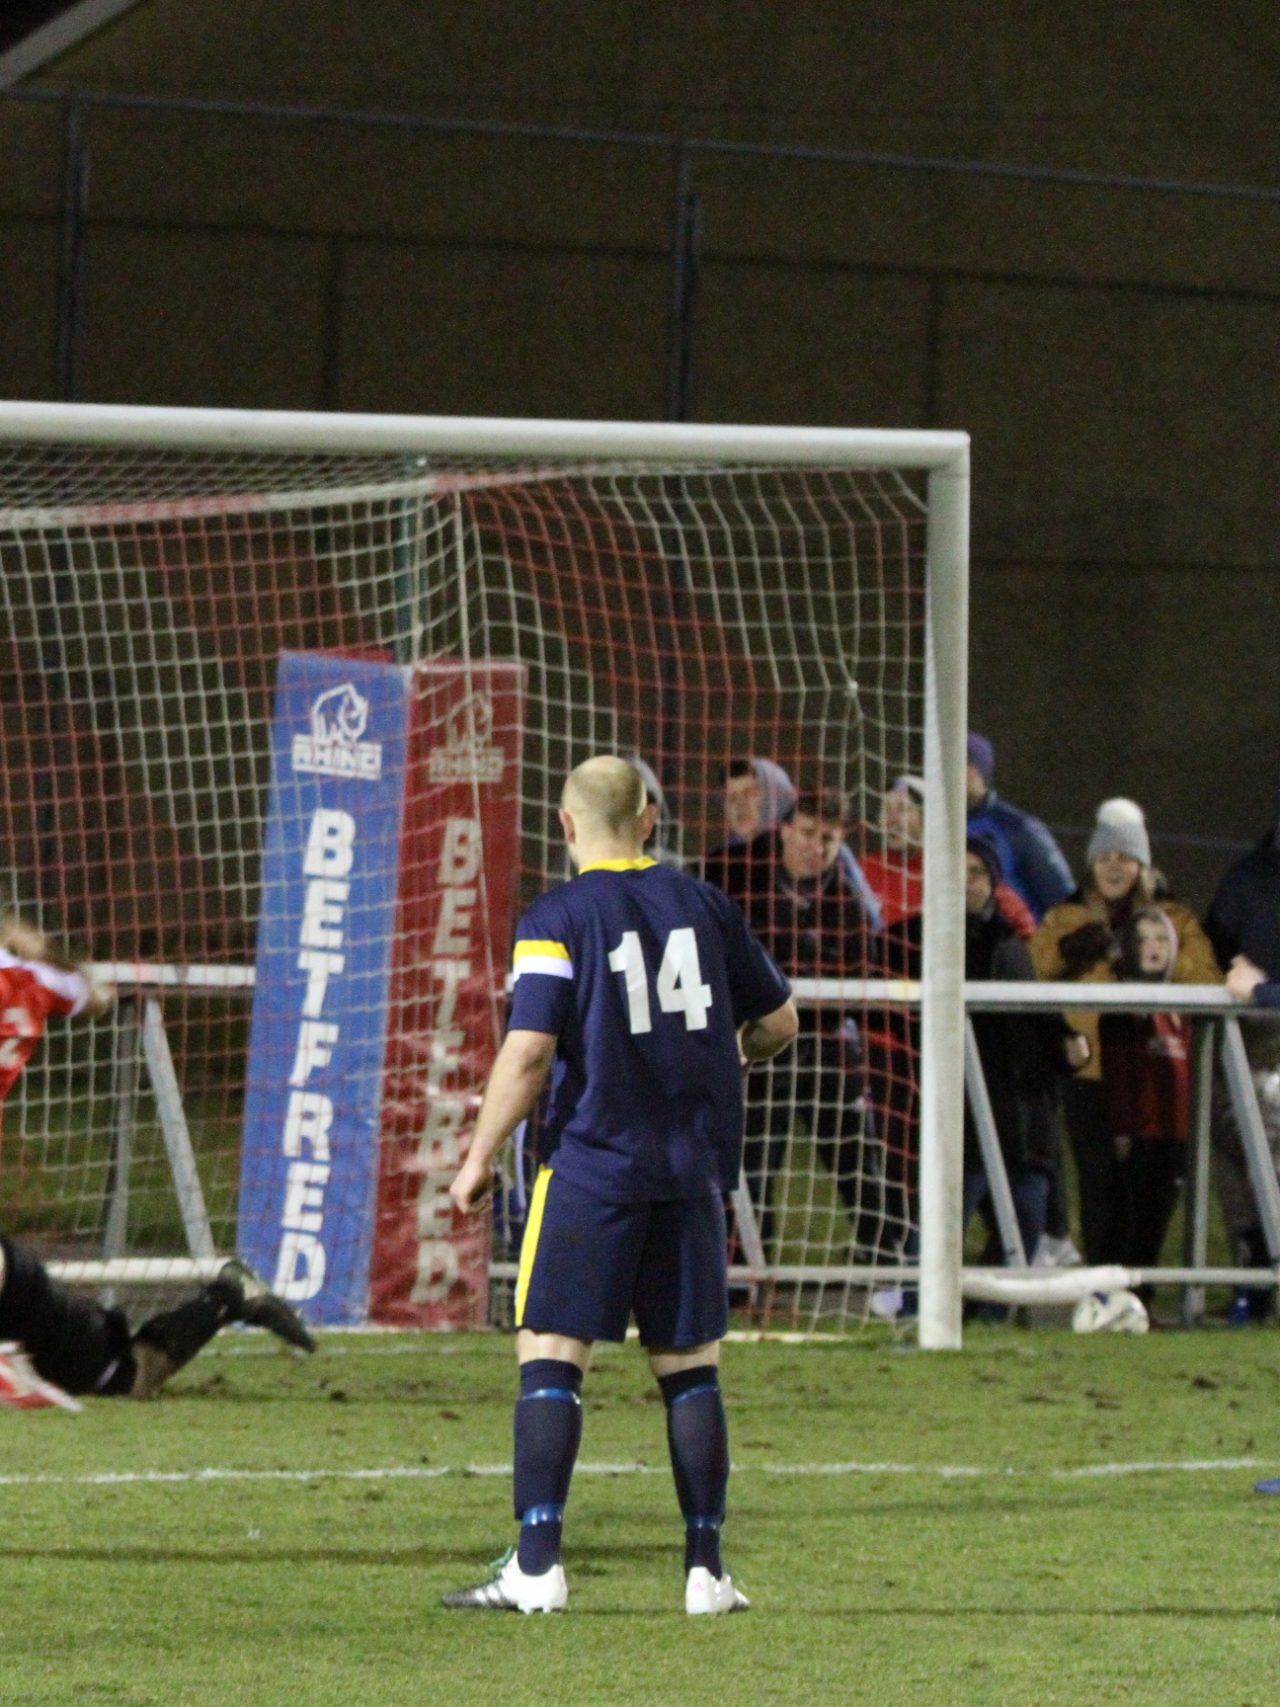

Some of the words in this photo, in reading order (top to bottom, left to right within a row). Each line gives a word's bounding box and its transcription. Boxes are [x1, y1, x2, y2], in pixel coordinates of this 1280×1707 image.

[292, 738, 382, 779] RHINO
[273, 807, 356, 1301] BETFRED
[410, 817, 480, 1302] BETFRED
[607, 927, 713, 1035] 14
